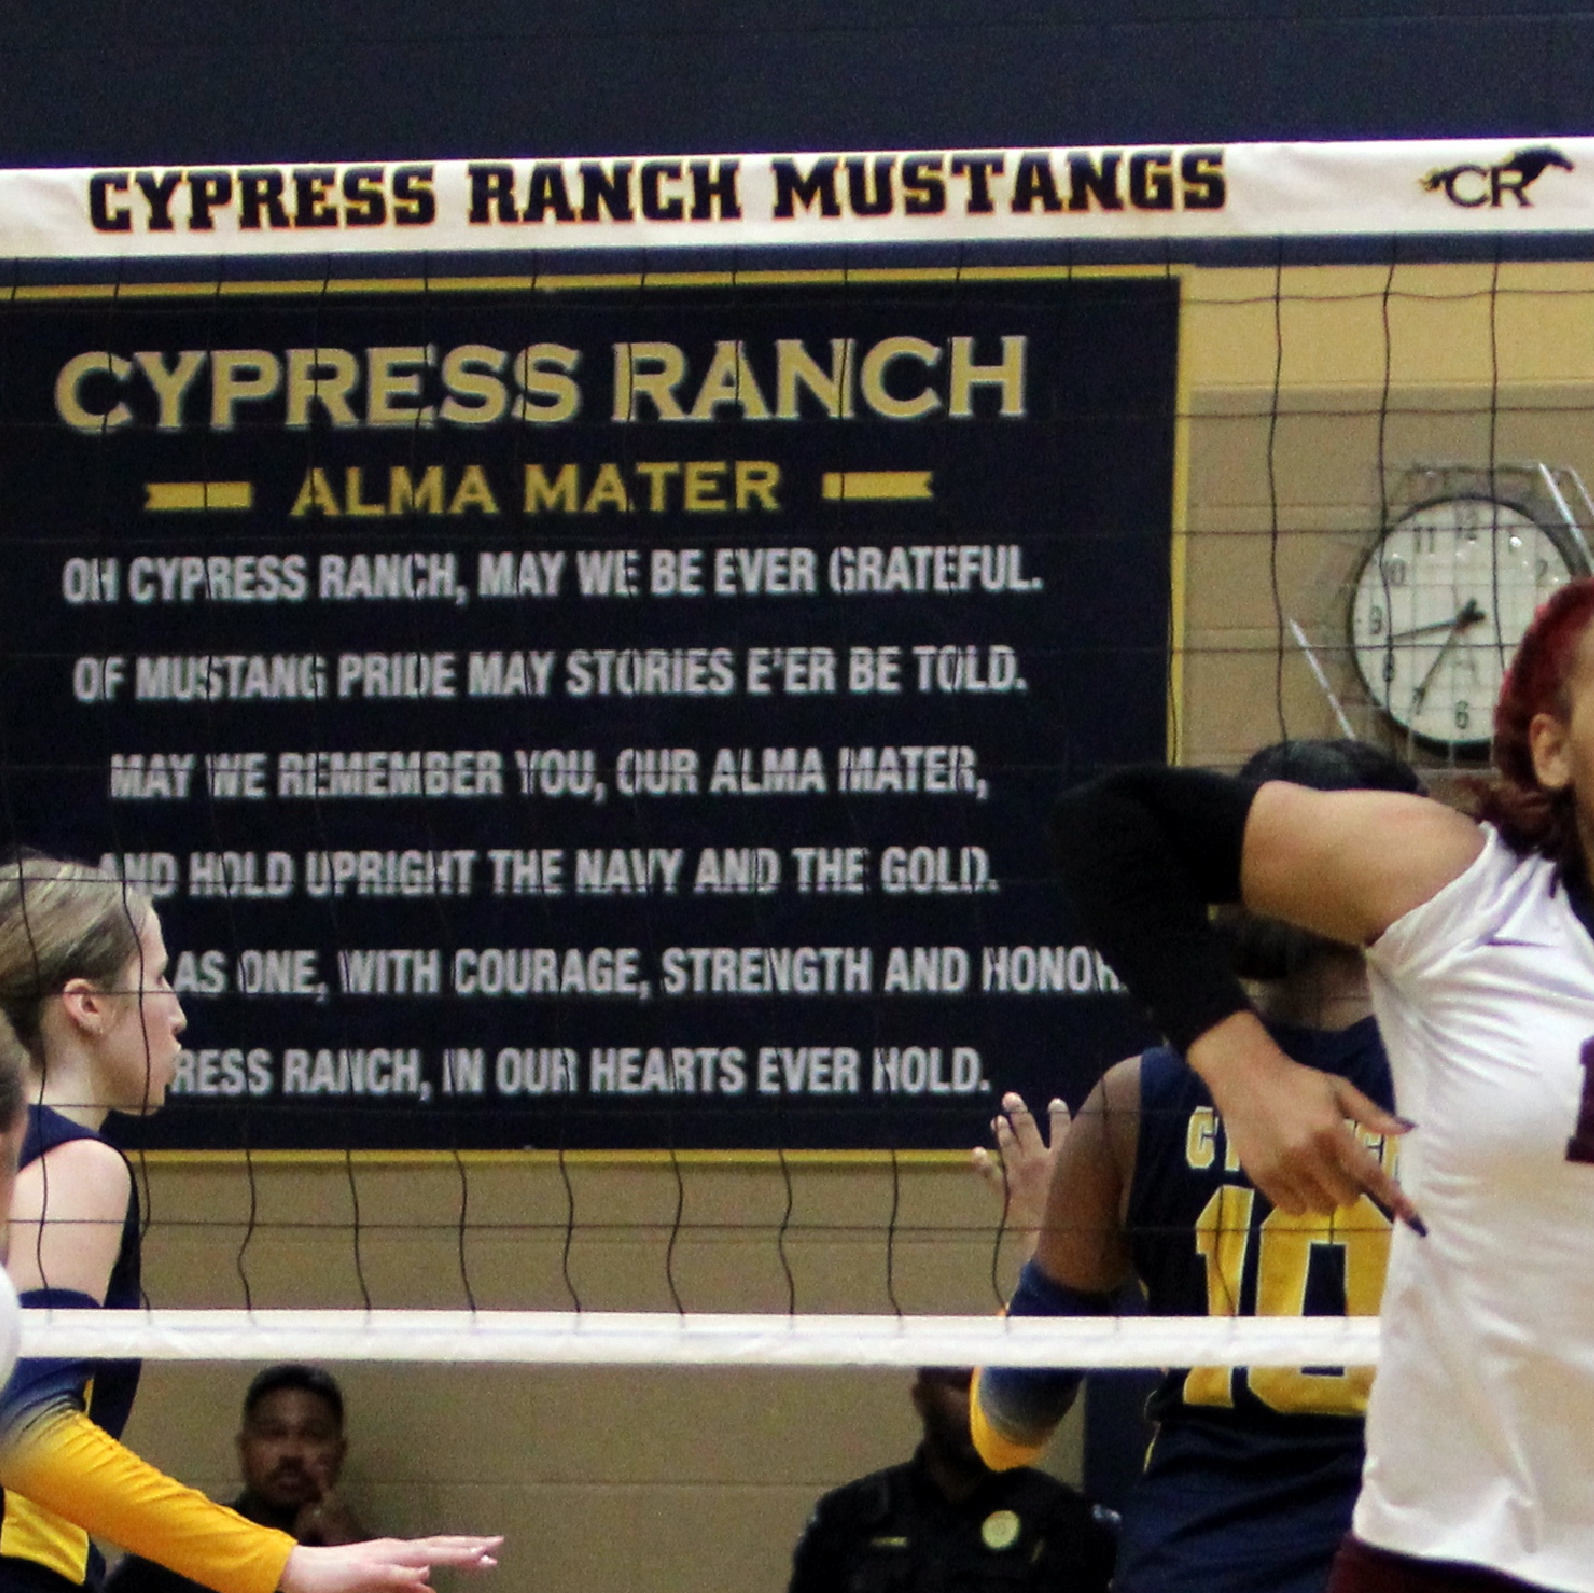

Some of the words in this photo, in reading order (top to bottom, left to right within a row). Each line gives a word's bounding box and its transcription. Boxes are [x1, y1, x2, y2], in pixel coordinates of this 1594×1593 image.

[89, 165, 436, 234] CYPRESS
[467, 157, 741, 225] RANCH
[771, 149, 1227, 221] MUSTANGS
[1444, 164, 1535, 209] CR
[54, 342, 582, 432] CYPRESS
[613, 335, 1029, 422] RANCH
[290, 465, 500, 517] ALMA
[524, 459, 782, 514] MATER
[62, 556, 121, 604] OH
[128, 555, 307, 603] CYPRESS
[318, 552, 469, 606] RANCH,
[476, 551, 566, 598] MAY
[575, 549, 642, 597] WE
[650, 547, 706, 597] BE
[713, 547, 818, 596] EVER
[829, 544, 1044, 594] GRATEFUL.
[73, 657, 125, 702] OF
[135, 653, 328, 702] MUSTANG
[337, 652, 457, 699] PRIDE
[467, 650, 556, 698] MAY
[565, 647, 736, 697] STORIES
[847, 645, 903, 694] BE
[911, 644, 1029, 693] TOLD.
[109, 753, 196, 799] MAY
[204, 751, 269, 799] WE
[276, 750, 504, 798] REMEMBER
[513, 748, 606, 806] YOU,
[615, 747, 700, 797] OUR
[709, 747, 828, 795] ALMA
[837, 745, 990, 800] MATER,
[188, 850, 296, 899] HOLD
[305, 849, 477, 898] UPRIGHT
[487, 849, 565, 896] THE
[574, 848, 683, 896] NAVY
[692, 847, 782, 895] AND
[791, 846, 870, 894] THE
[879, 845, 1001, 894] GOLD.
[173, 949, 227, 994] AS
[239, 949, 330, 1003] ONE,
[337, 949, 442, 995] WITH
[453, 947, 652, 1002] COURAGE,
[661, 946, 873, 995] STRENGTH
[884, 946, 970, 993] AND
[282, 1047, 434, 1101] RANCH,
[442, 1048, 486, 1094] IN
[495, 1047, 580, 1094] OUR
[589, 1046, 747, 1094] HEARTS
[757, 1046, 861, 1093] EVER
[872, 1046, 991, 1093] HOLD.
[1182, 1184, 1395, 1418] 10
